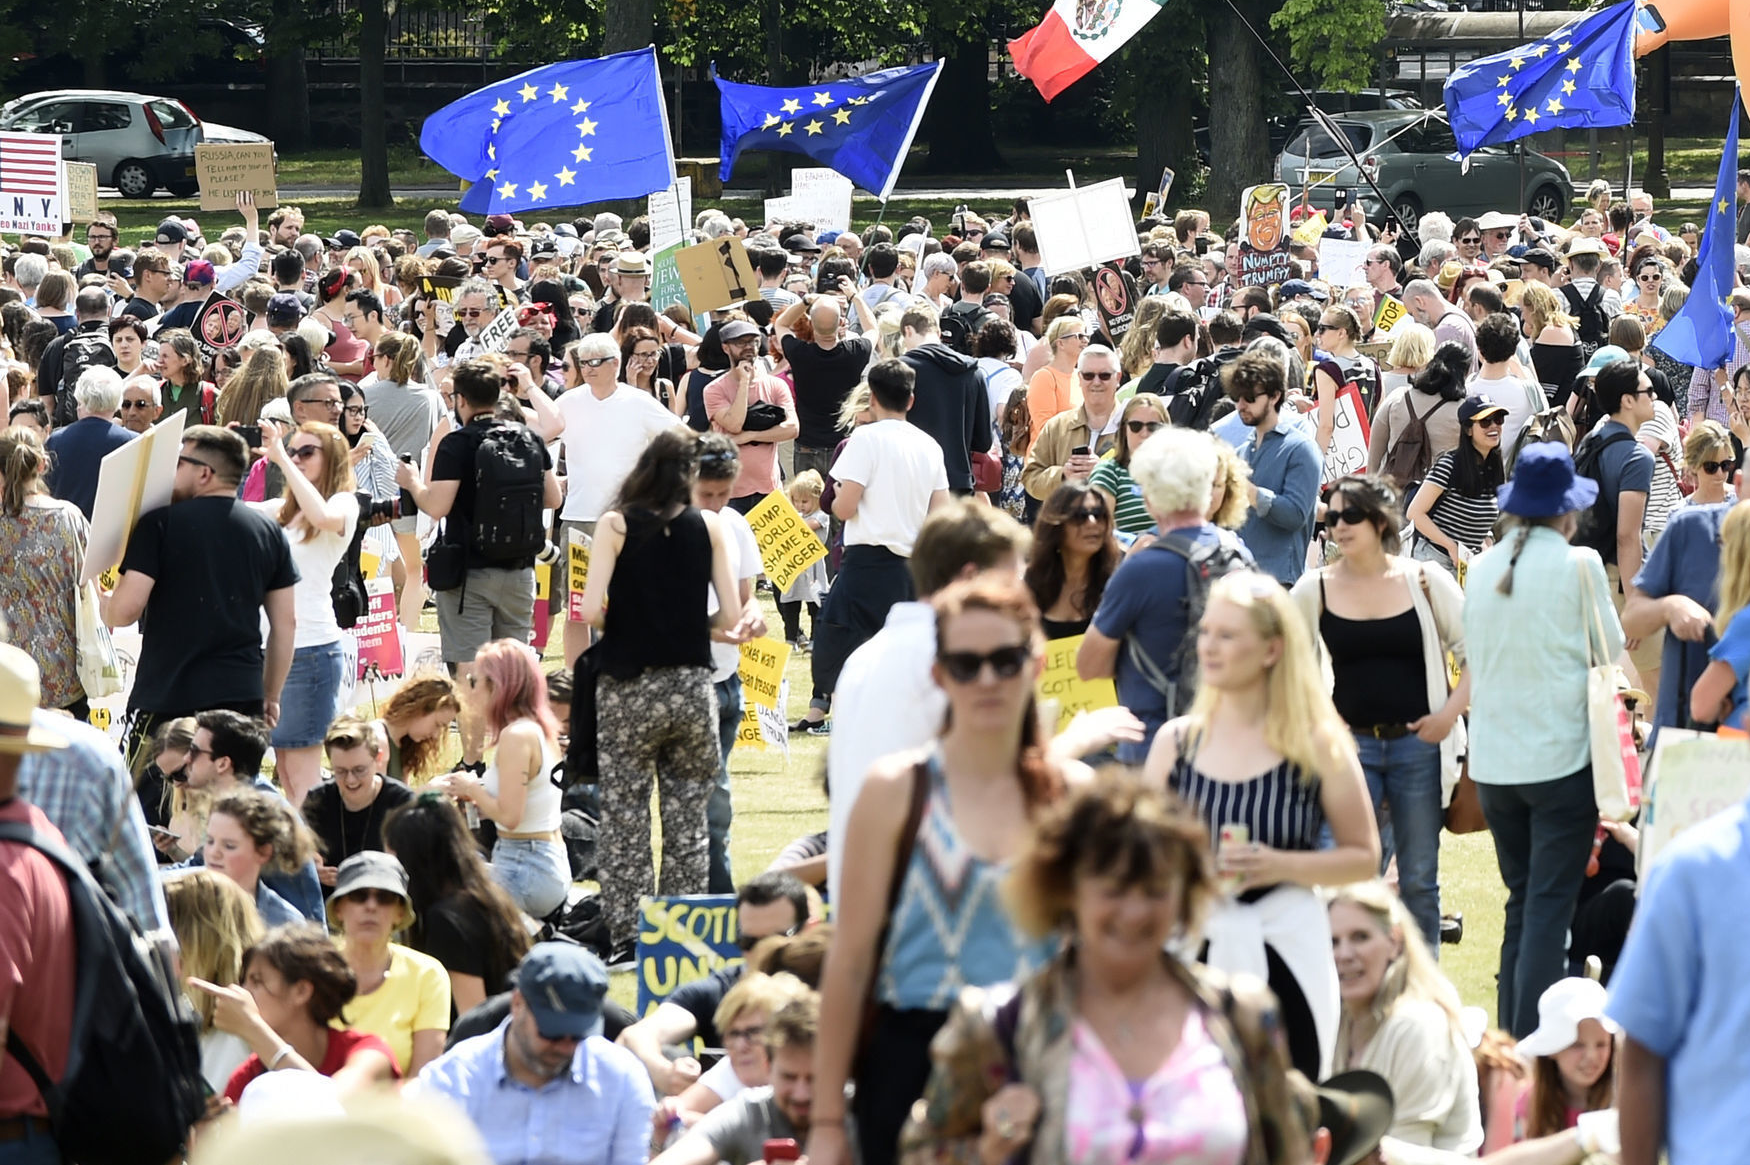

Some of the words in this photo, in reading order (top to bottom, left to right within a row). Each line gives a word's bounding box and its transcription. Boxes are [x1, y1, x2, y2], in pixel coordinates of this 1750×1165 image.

[12, 219, 29, 230] Nazi
[31, 220, 57, 232] Yanks
[1243, 251, 1289, 272] NUMPTY
[656, 265, 682, 289] JEW
[482, 311, 514, 349] FREE
[1378, 300, 1400, 333] STOP
[750, 504, 787, 536] RUMP,
[763, 534, 801, 573] SHAME
[800, 527, 811, 539] &
[766, 539, 823, 586] DANGER!
[356, 610, 394, 625] orkers
[358, 636, 383, 650] hem
